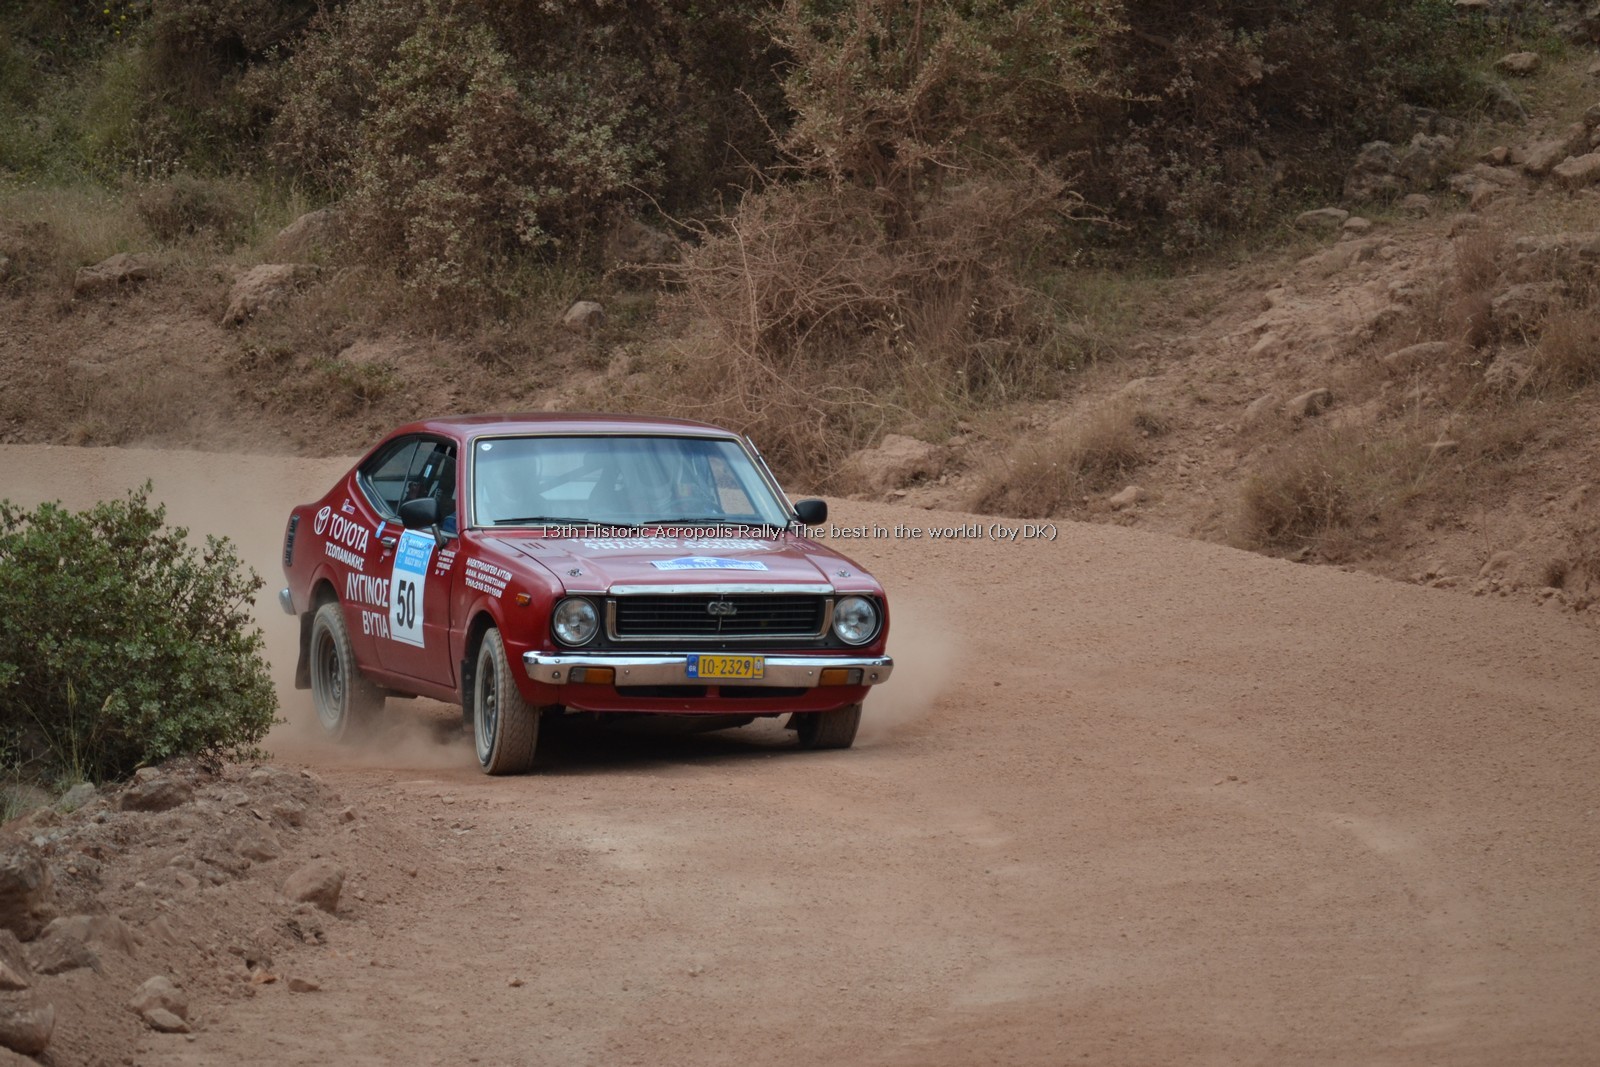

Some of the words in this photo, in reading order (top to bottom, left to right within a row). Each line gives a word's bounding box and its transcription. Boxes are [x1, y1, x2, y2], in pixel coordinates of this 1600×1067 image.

[329, 513, 369, 553] TOYOTA
[325, 541, 365, 571] ΤΣΟΠΑΝΑΚΗΣ
[346, 572, 389, 608] ΛΥΓΙΝΟΣ
[396, 579, 415, 630] 50
[362, 610, 390, 639] ΒΥΤΙΑ
